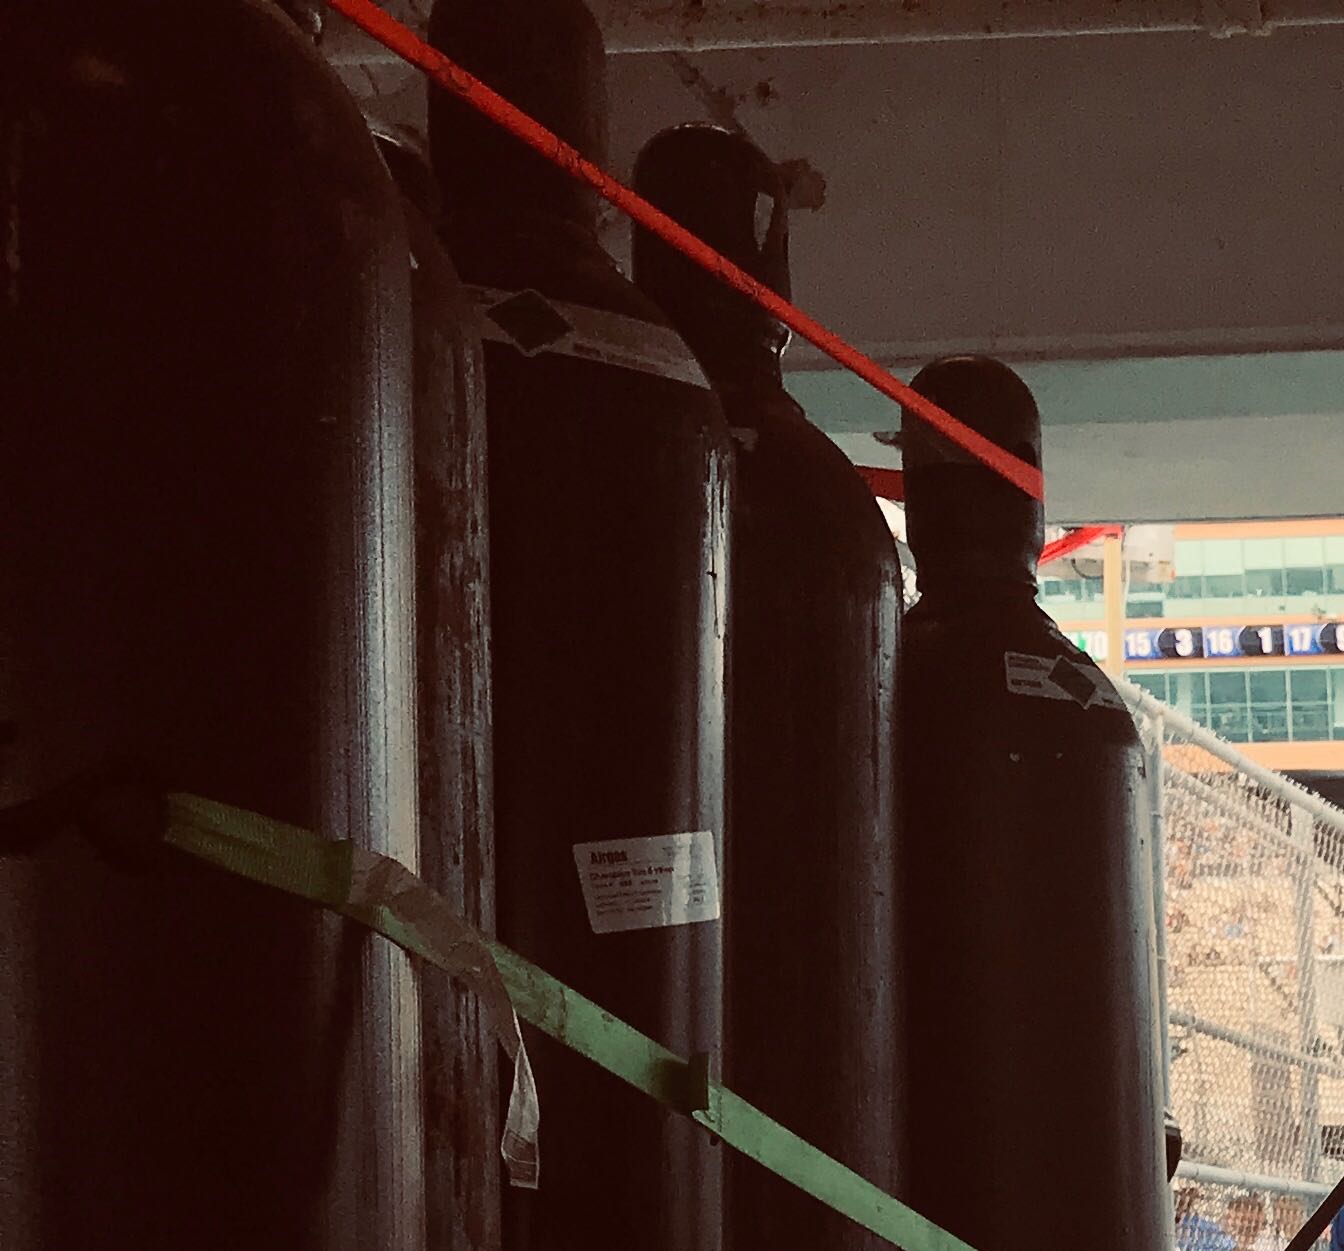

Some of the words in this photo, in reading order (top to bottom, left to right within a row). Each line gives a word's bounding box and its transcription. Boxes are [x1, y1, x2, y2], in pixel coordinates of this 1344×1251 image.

[1125, 632, 1151, 657] 15
[1174, 628, 1194, 657] 3
[1207, 630, 1233, 655] 16
[1257, 626, 1273, 654] 1
[1288, 628, 1312, 652] 17
